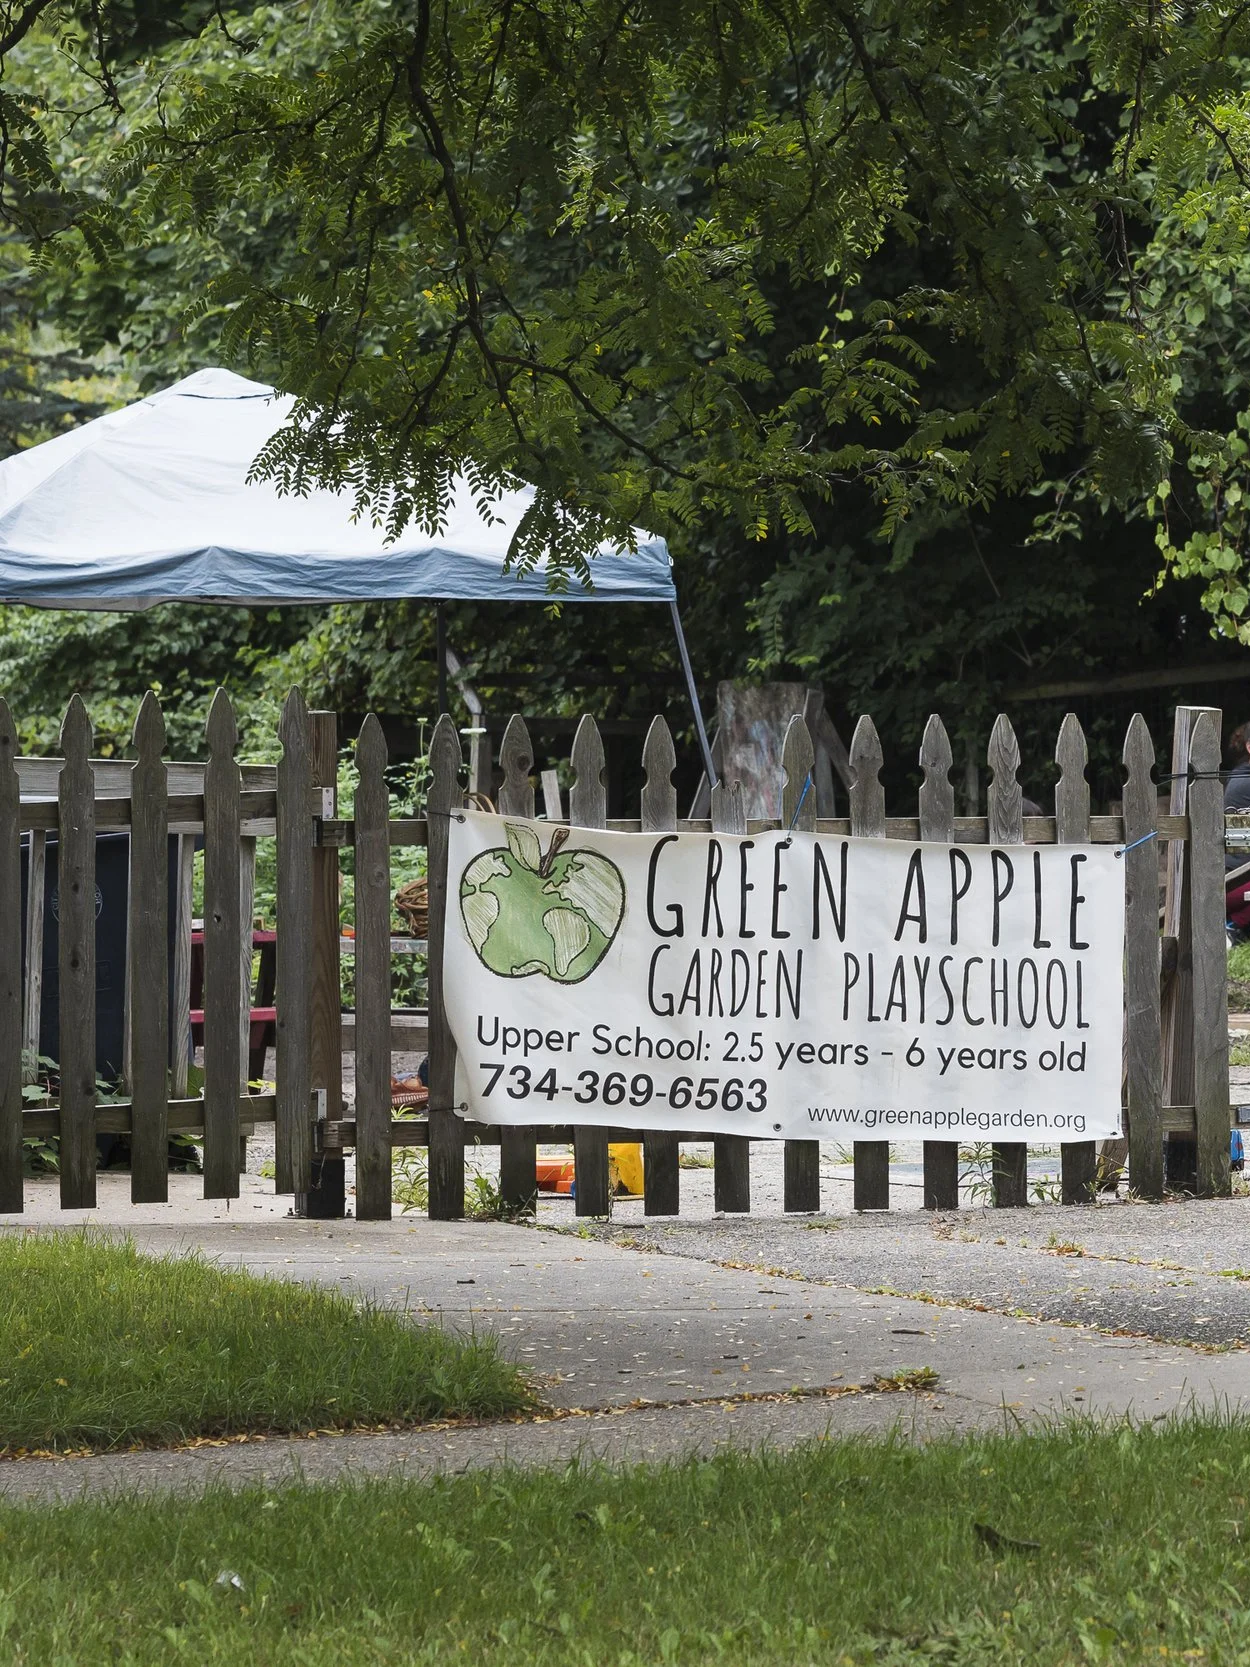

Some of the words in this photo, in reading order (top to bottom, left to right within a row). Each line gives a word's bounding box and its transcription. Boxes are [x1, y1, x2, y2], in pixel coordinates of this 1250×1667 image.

[647, 835, 848, 942] GREEN
[894, 848, 1090, 950] APPLE
[648, 944, 803, 1021] GARDEN
[843, 952, 1090, 1030] PLAYSCHOOL
[477, 1015, 580, 1058] Upper
[592, 1024, 711, 1063] School:
[723, 1031, 764, 1063] 2.5
[776, 1041, 869, 1071] years
[906, 1037, 925, 1068] 6
[937, 1047, 1028, 1076] years
[1039, 1040, 1087, 1072] old
[479, 1062, 768, 1113] 734-369-6563
[808, 1107, 1086, 1133] www.greenapplegarden.org
